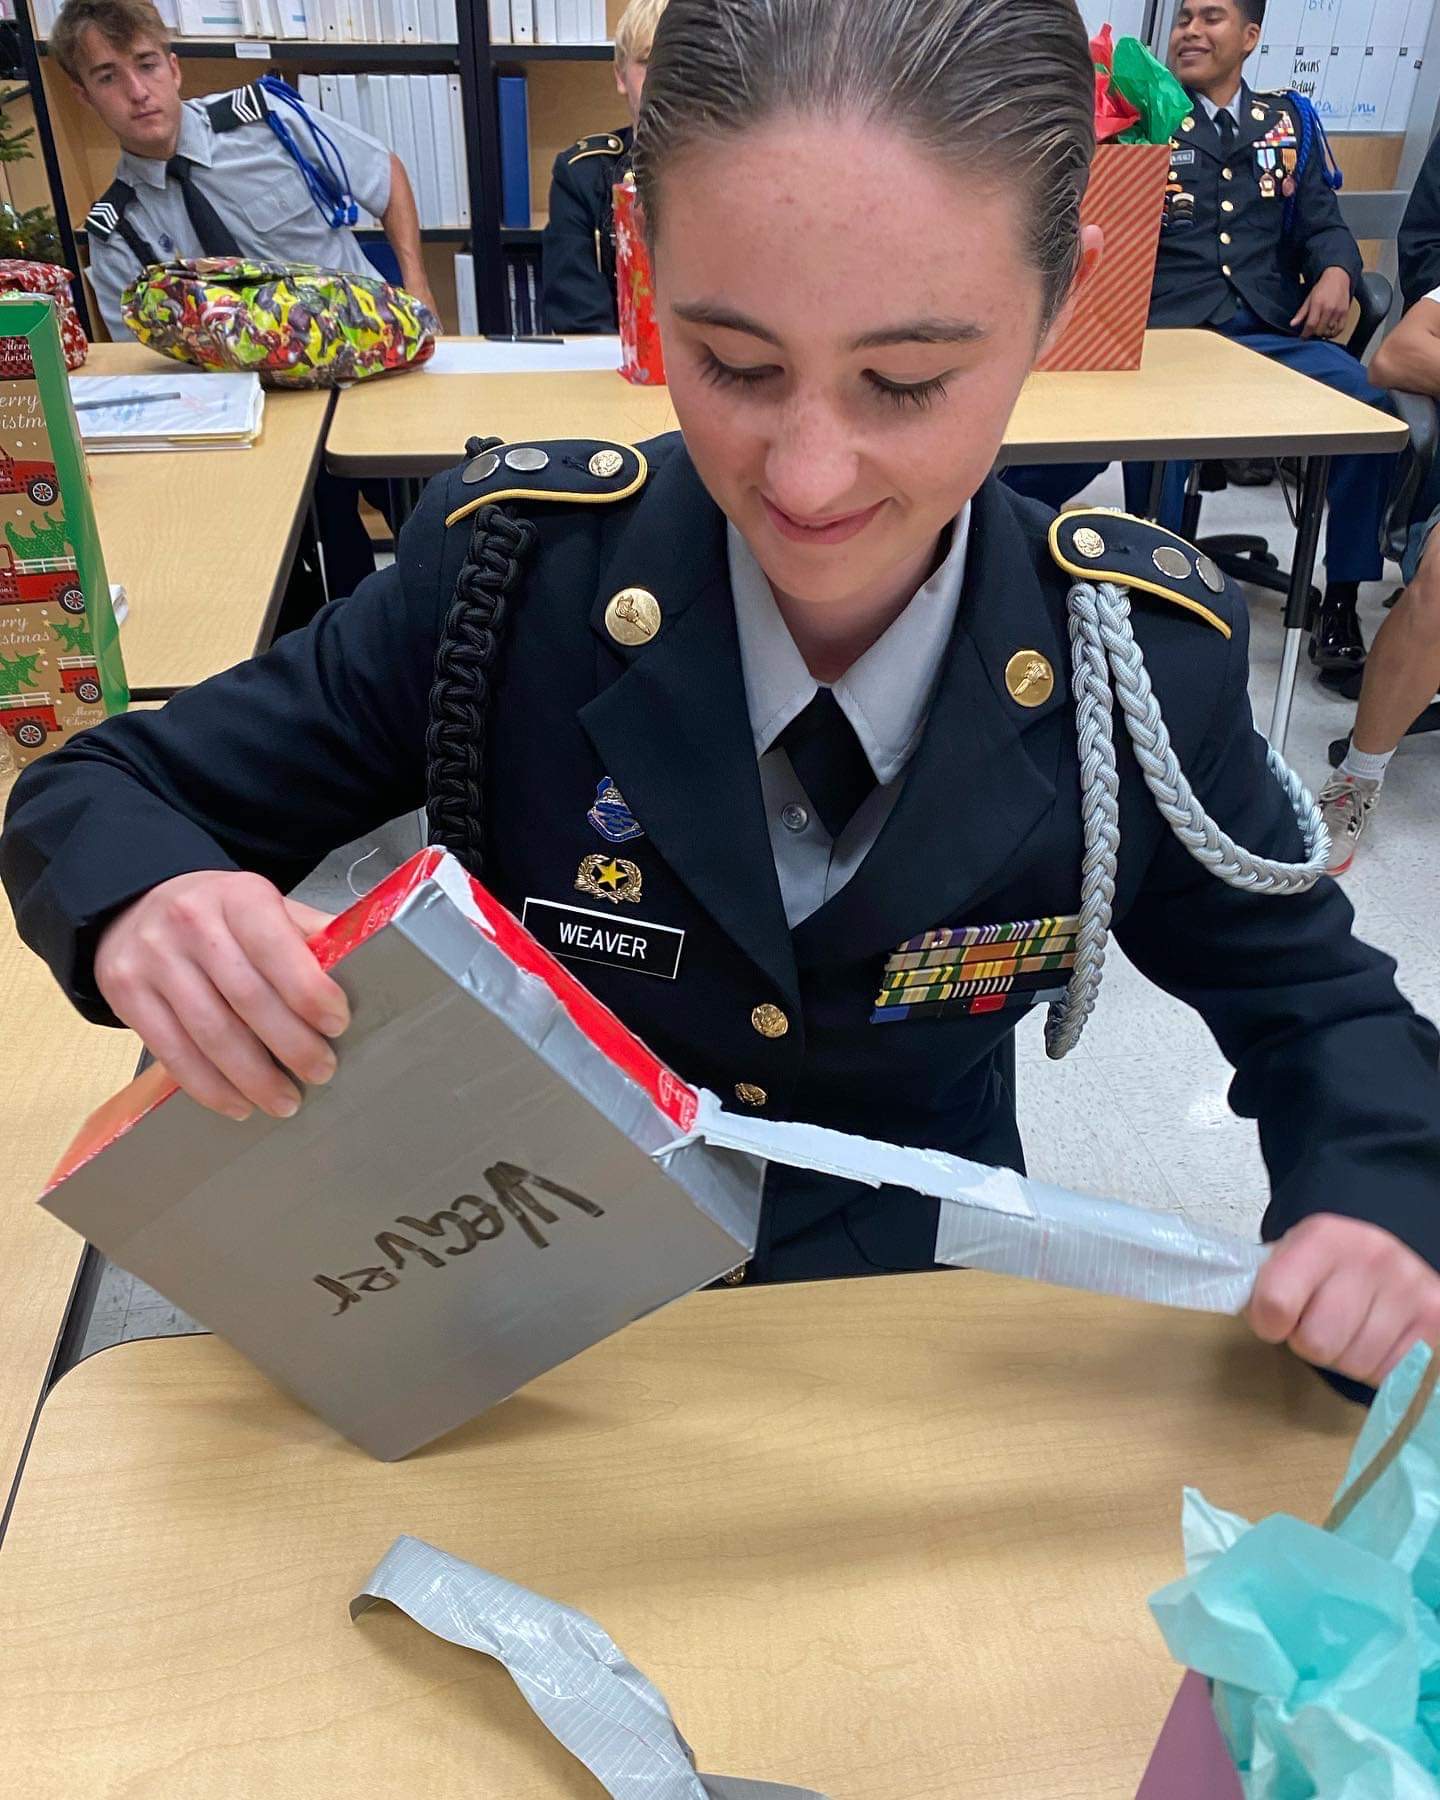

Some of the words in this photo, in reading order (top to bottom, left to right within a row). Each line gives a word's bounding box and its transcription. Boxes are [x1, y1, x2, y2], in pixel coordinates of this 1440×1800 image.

[2, 413, 48, 429] istm
[559, 921, 647, 960] WEAVER
[313, 1161, 604, 1316] Weaver
